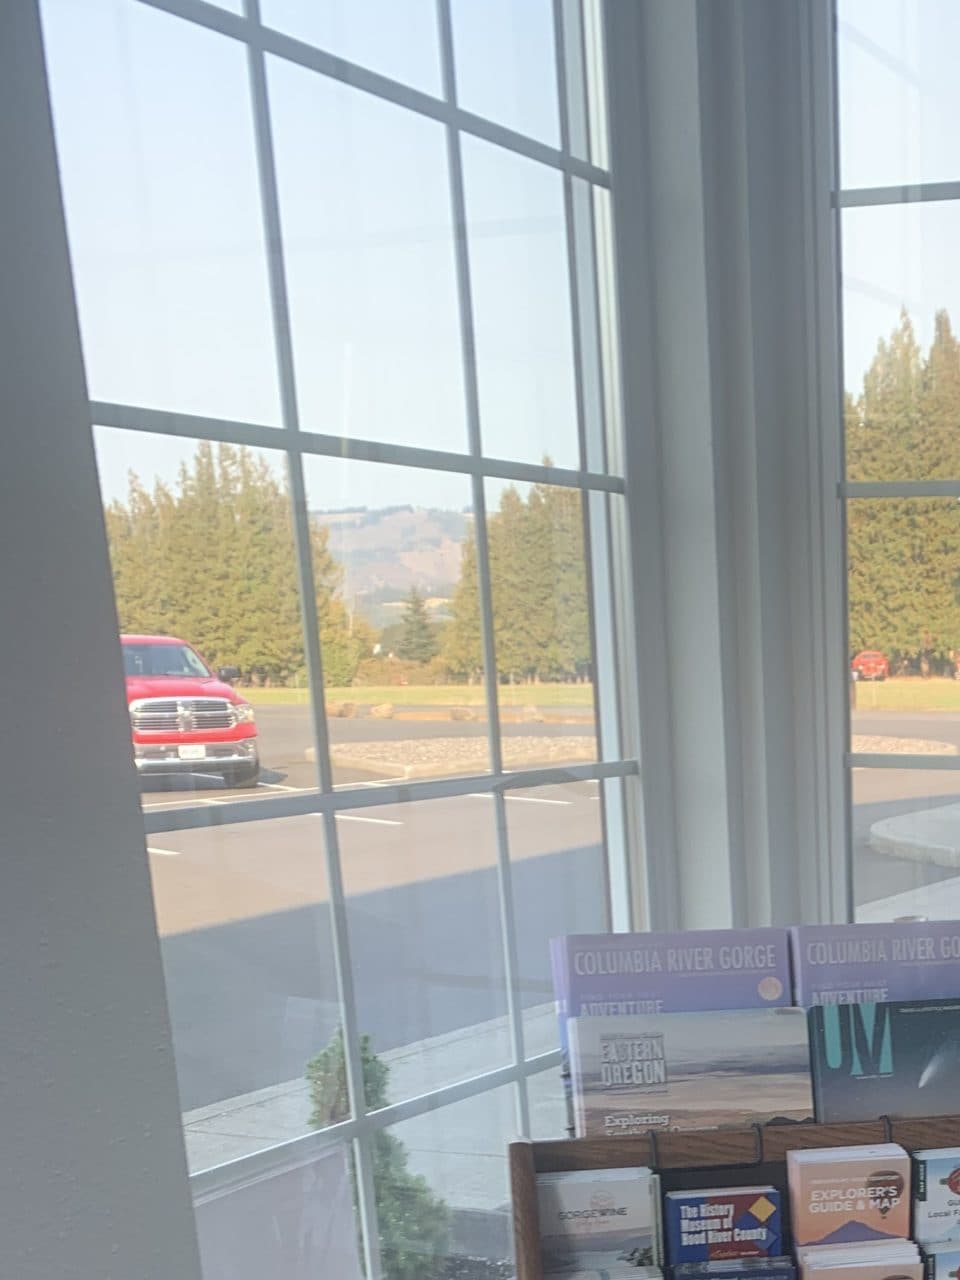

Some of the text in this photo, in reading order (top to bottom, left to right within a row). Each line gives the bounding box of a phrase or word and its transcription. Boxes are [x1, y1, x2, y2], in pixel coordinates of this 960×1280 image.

[575, 944, 776, 976] COLUMBIA RIVER GORGE
[807, 940, 888, 965] COLUMBIA
[892, 937, 935, 960] RIVER
[600, 1038, 664, 1062] EASTERN
[600, 1061, 666, 1087] OREGON
[604, 1111, 670, 1129] Exploring
[811, 1186, 898, 1202] EXPLORER'S
[680, 1203, 735, 1219] The History
[809, 1197, 900, 1213] GUIDE & MAP
[680, 1217, 733, 1233] Museum of
[681, 1226, 768, 1246] Hood River County
